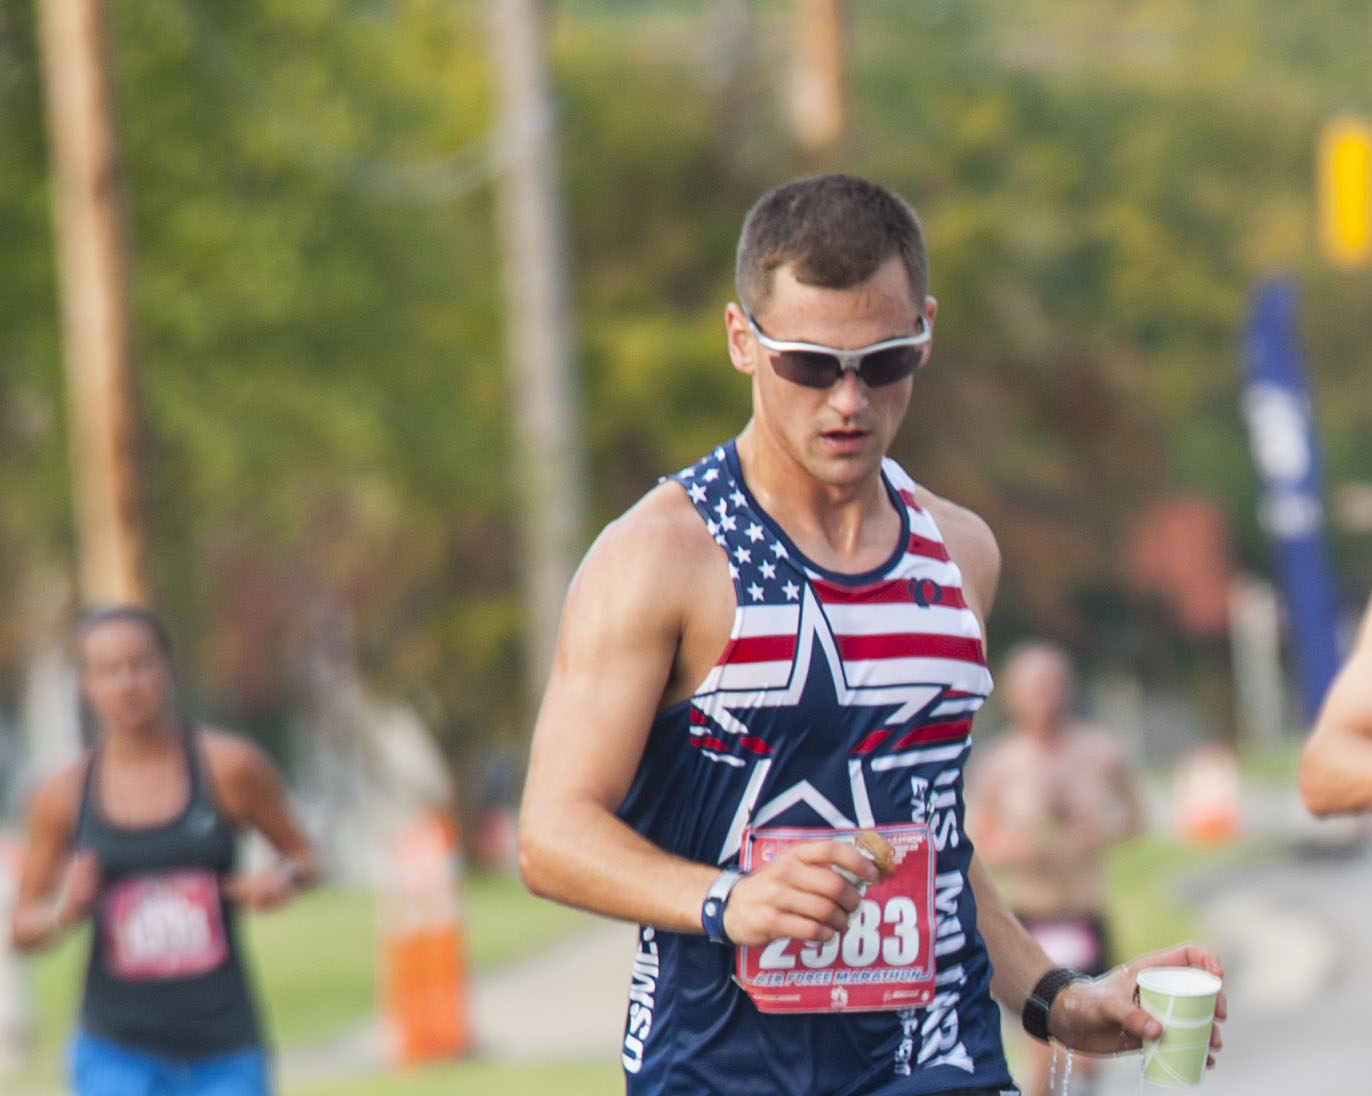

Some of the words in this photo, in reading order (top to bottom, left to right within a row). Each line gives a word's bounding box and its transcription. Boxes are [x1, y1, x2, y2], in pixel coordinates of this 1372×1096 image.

[752, 971, 785, 988] AIR
[785, 969, 833, 987] FORCE
[832, 965, 924, 986] MARATHON
